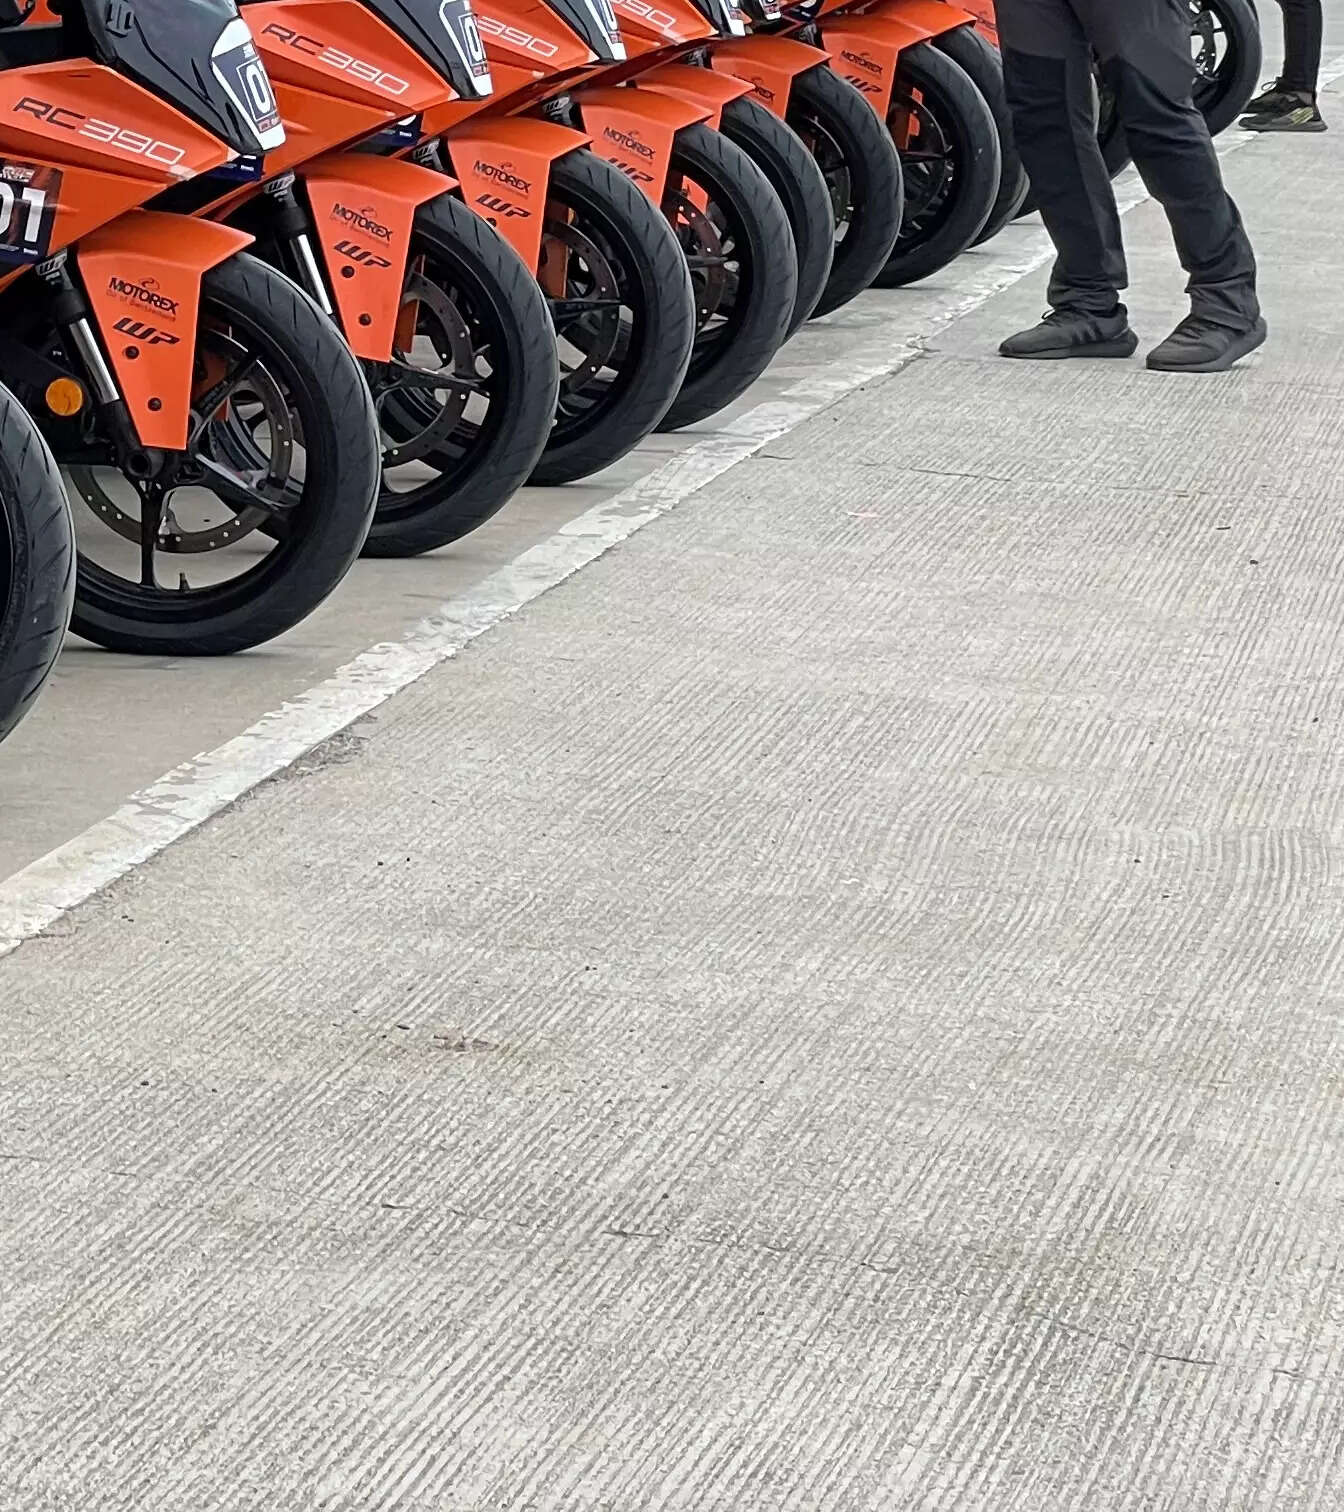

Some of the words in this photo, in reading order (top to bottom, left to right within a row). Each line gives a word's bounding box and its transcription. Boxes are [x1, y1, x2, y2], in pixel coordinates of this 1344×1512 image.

[463, 16, 484, 62] 0
[477, 16, 560, 58] 390
[246, 60, 272, 114] 0
[603, 126, 656, 160] MOTOREX
[473, 160, 532, 194] MOTOREX
[332, 202, 394, 241] MOTOREX
[109, 277, 180, 316] MOTOREX
